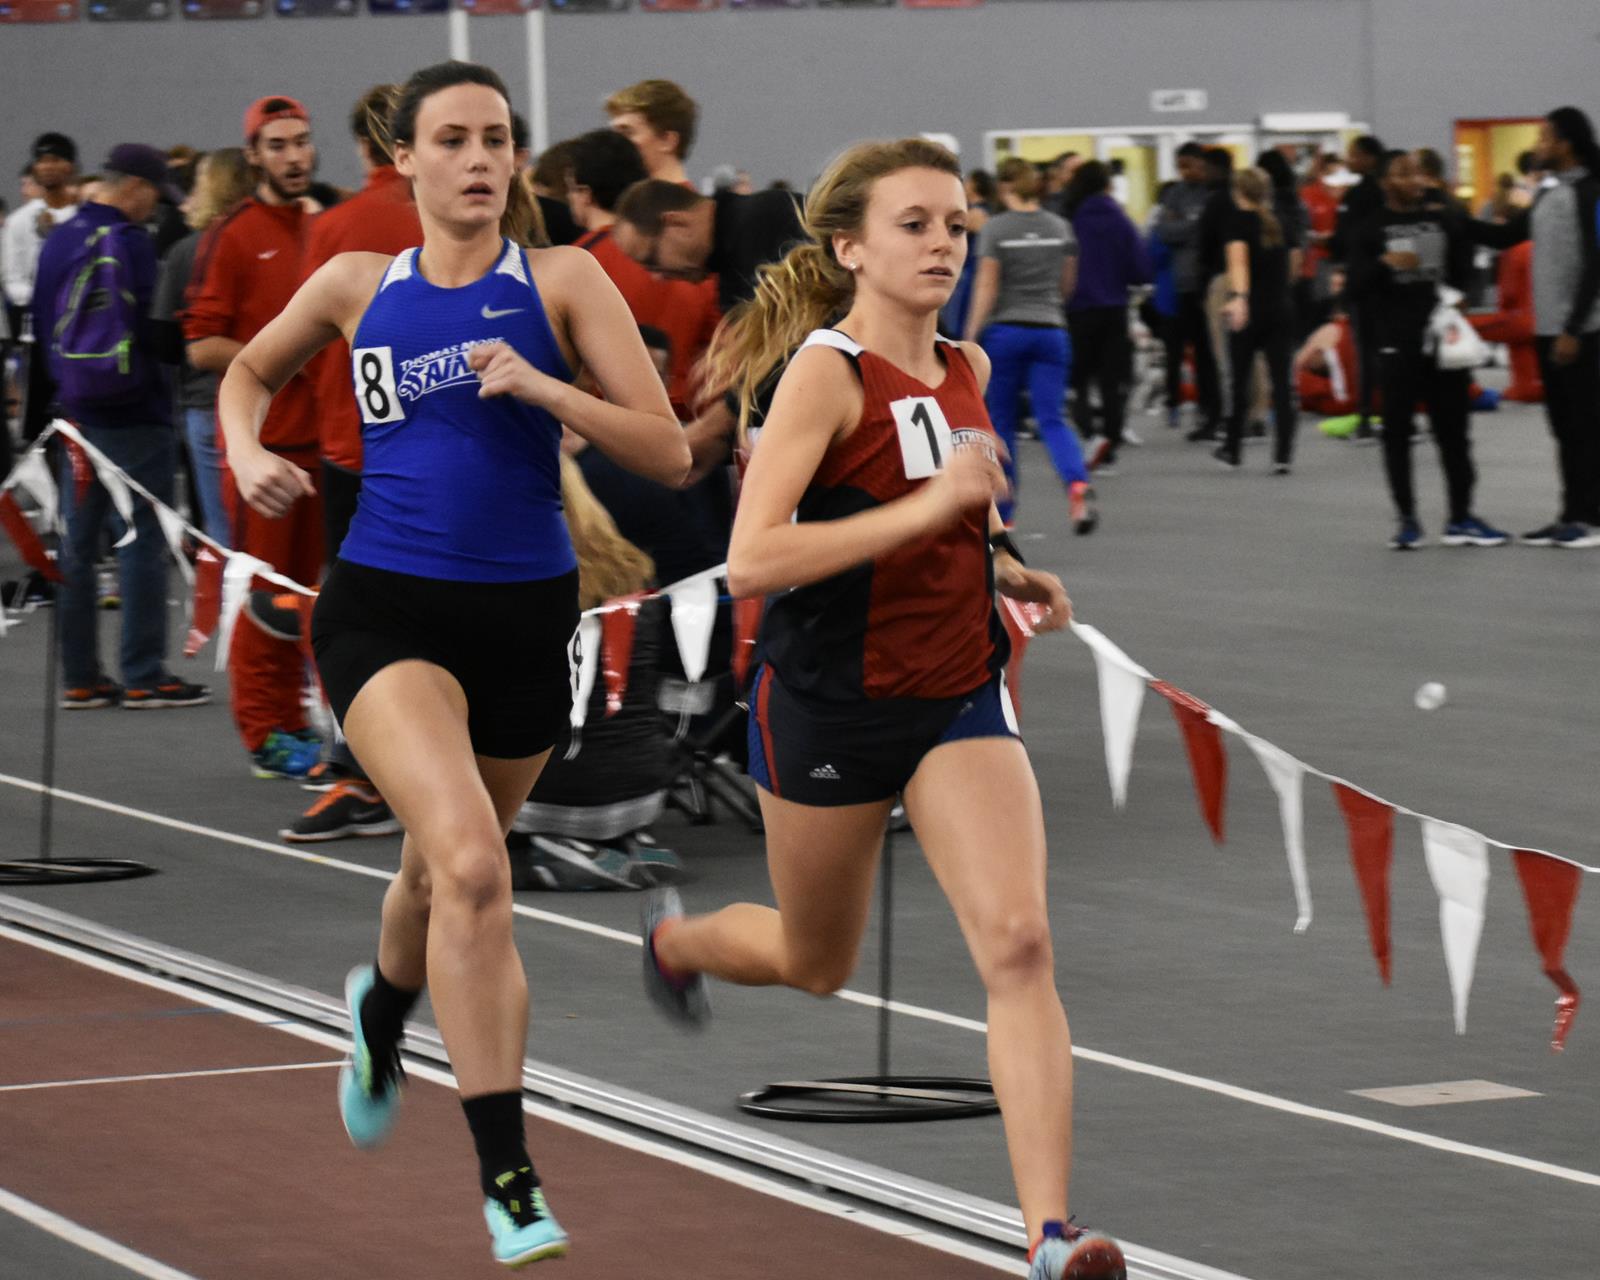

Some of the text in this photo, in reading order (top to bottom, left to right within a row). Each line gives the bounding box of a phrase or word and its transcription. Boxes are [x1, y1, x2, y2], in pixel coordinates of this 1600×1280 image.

[361, 352, 390, 419] 8
[397, 351, 475, 401] SAIN
[400, 344, 461, 371] THOMAS
[910, 402, 943, 469] 1
